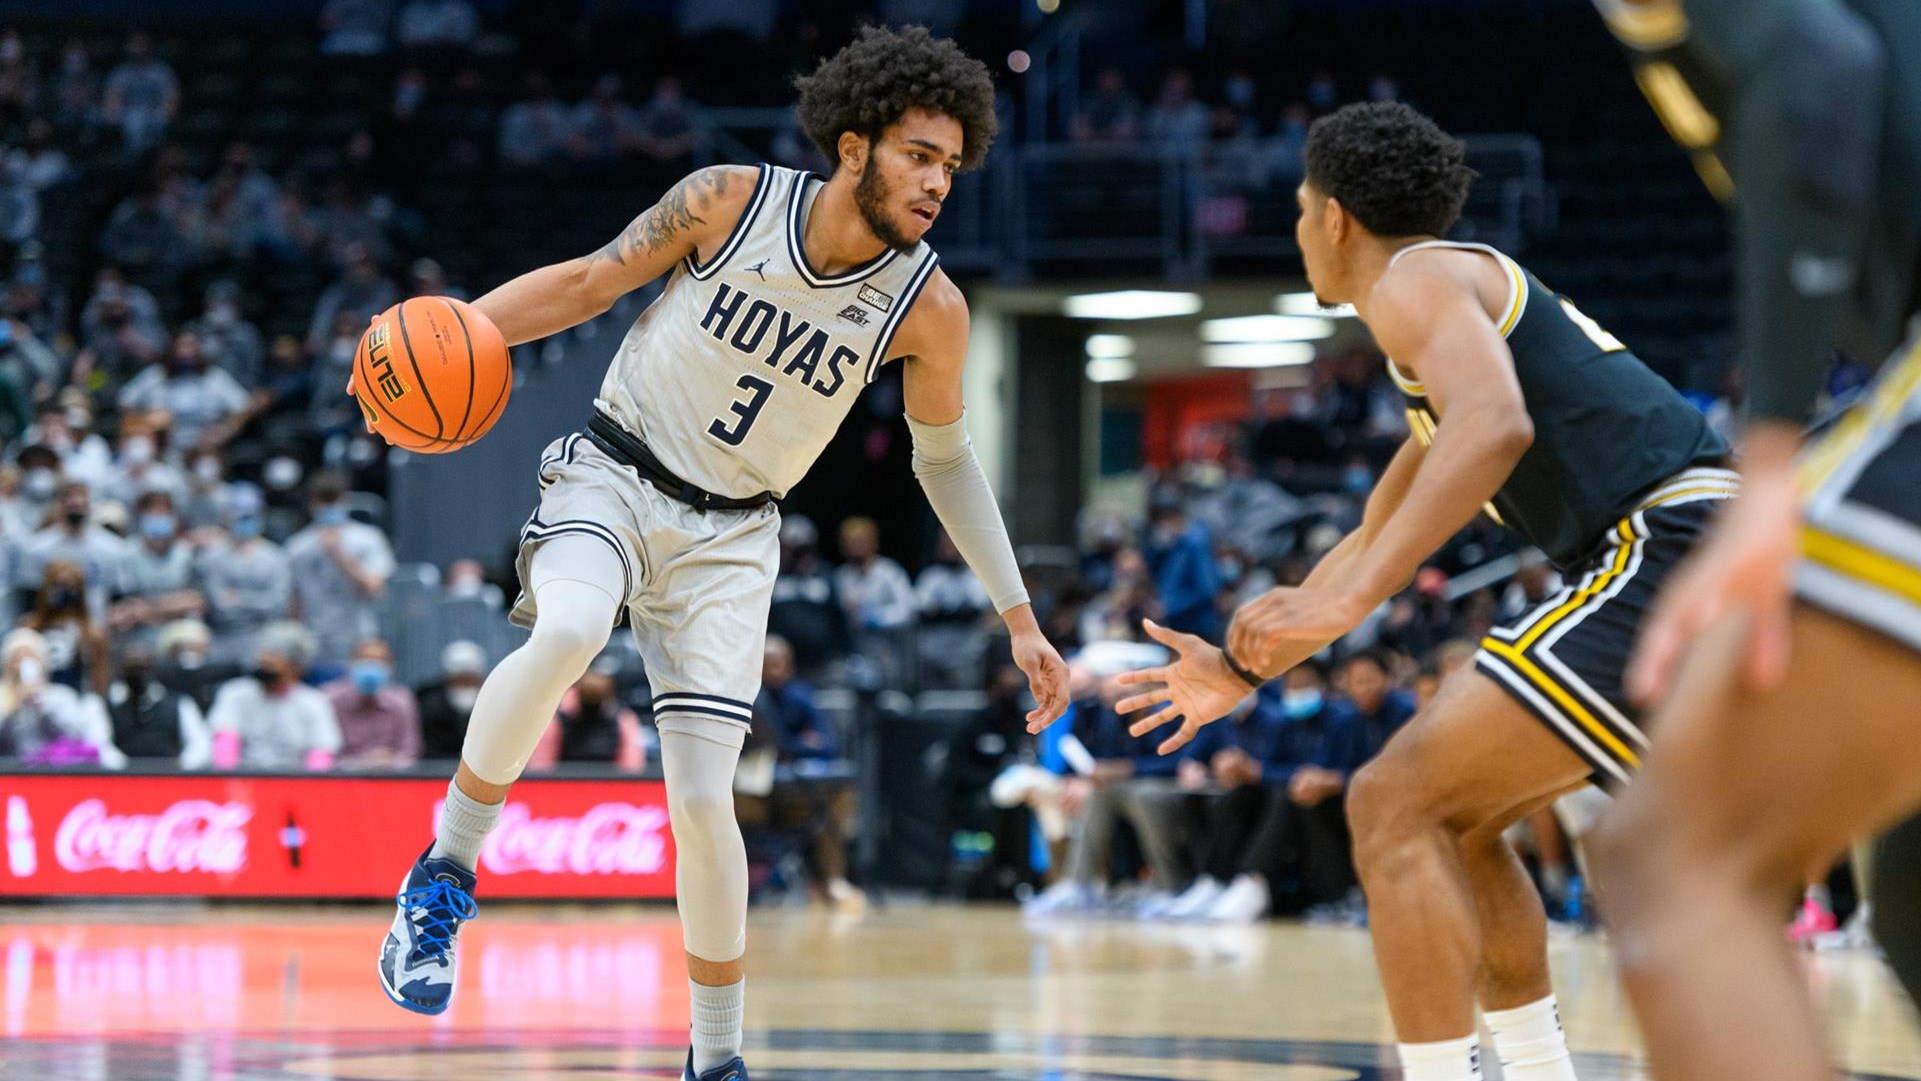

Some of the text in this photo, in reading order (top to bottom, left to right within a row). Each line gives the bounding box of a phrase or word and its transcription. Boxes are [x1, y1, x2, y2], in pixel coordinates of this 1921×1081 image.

[700, 282, 860, 398] HOYAS
[840, 309, 871, 326] EAST
[847, 304, 868, 318] BIG
[368, 325, 406, 403] ELITE
[706, 374, 775, 447] 3
